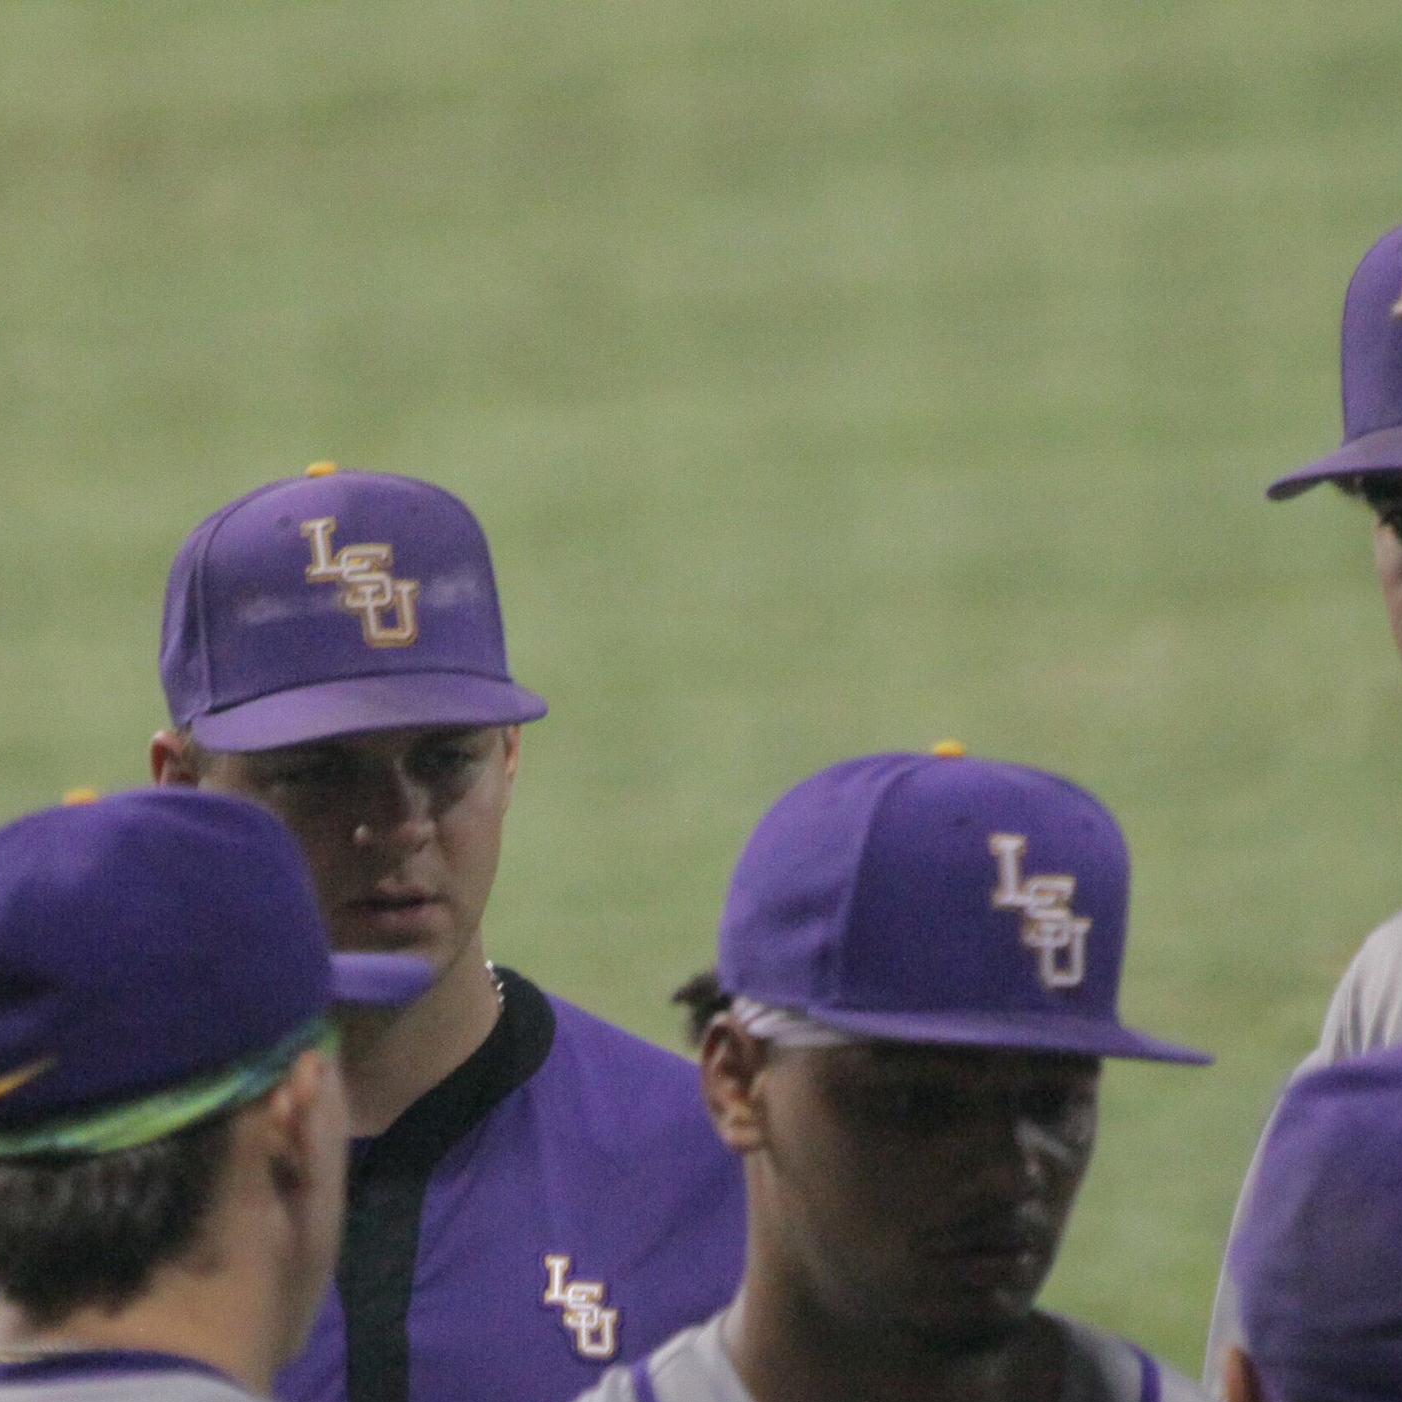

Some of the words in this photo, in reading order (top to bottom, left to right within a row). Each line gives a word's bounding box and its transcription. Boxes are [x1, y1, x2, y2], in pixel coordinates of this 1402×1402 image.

[300, 517, 419, 648] LSU
[988, 833, 1092, 988] LSU
[544, 1254, 618, 1357] LSU
